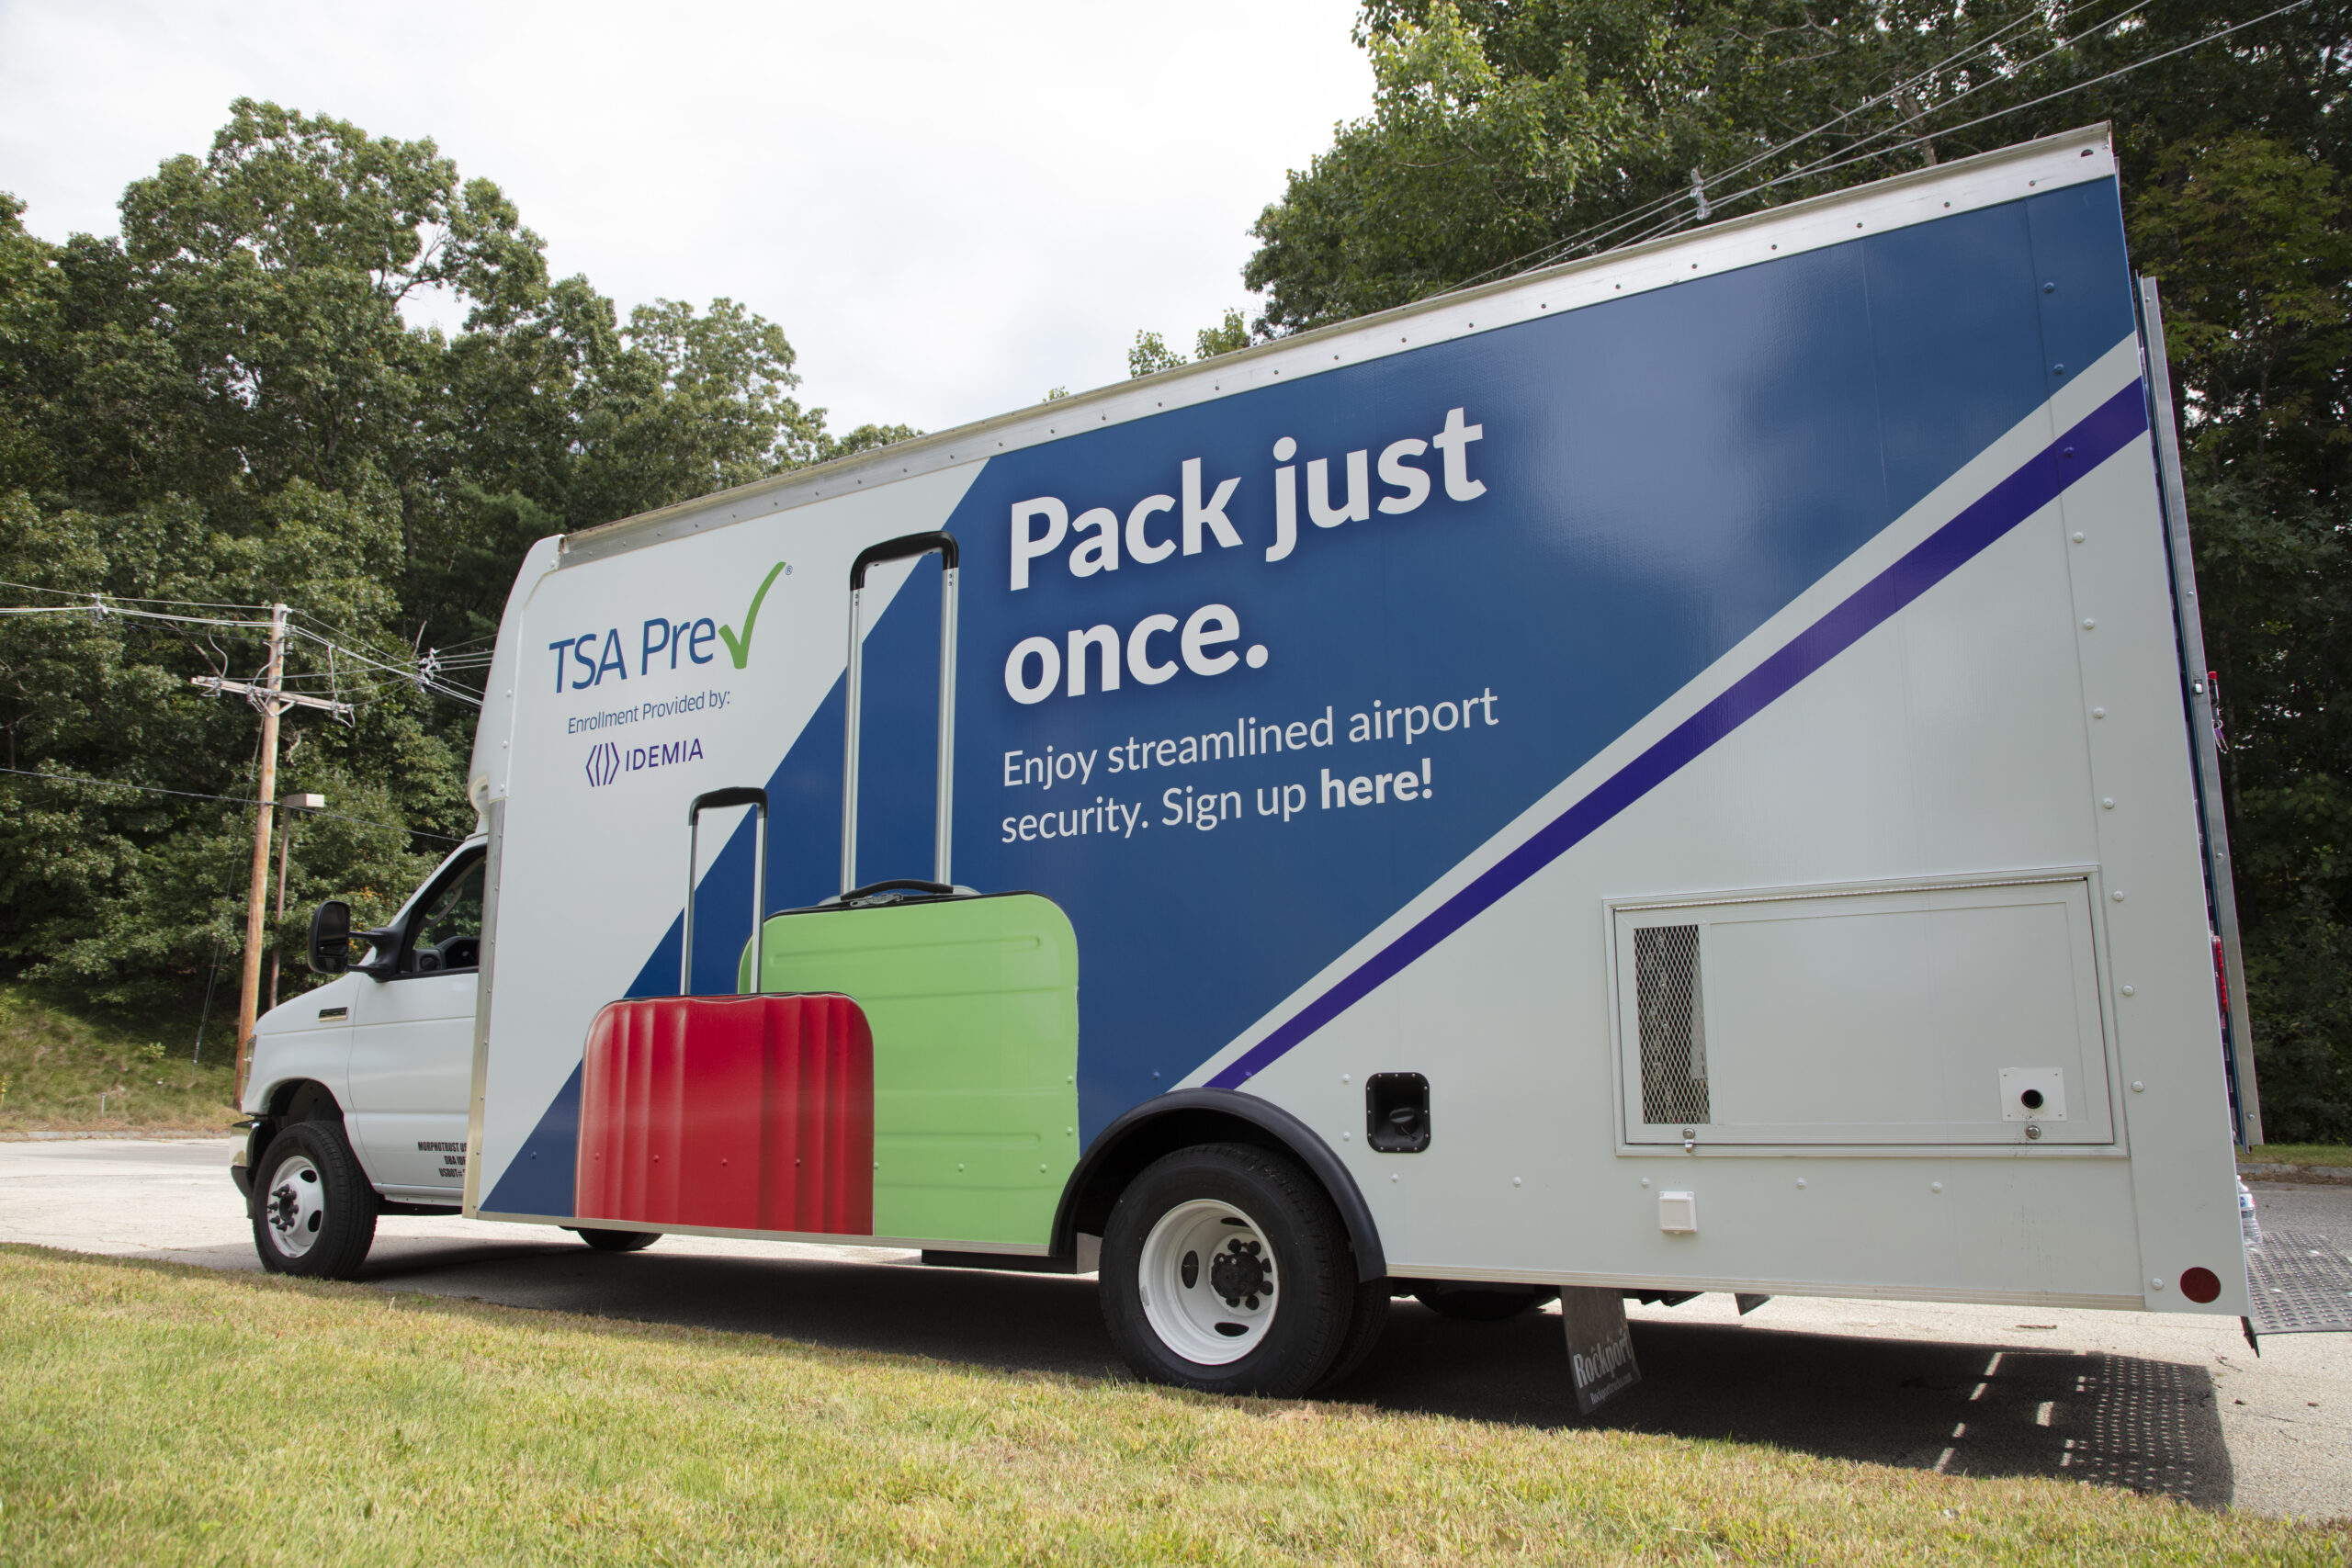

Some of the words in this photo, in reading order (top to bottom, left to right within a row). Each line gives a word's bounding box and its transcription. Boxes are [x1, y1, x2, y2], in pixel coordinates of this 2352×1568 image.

[1011, 457, 1244, 591] Pack
[1266, 407, 1487, 562] just
[548, 628, 628, 694] TSA
[641, 617, 716, 676] Pre
[1004, 604, 1269, 705] once.
[568, 705, 639, 734] Enrollment
[642, 692, 705, 720] Provided
[708, 690, 731, 712] by:
[1004, 746, 1098, 790] Enjoy
[1107, 705, 1334, 773] streamlined
[1349, 687, 1499, 745] airport
[626, 739, 705, 772] IDEMIA
[1001, 795, 1148, 843] security.
[1162, 787, 1242, 830] Sign
[1257, 782, 1306, 822] up
[1321, 757, 1432, 809] here!
[418, 1141, 459, 1152] MORPHOTRUST
[444, 1156, 457, 1165] DBA
[1573, 1331, 1632, 1389] Rockport
